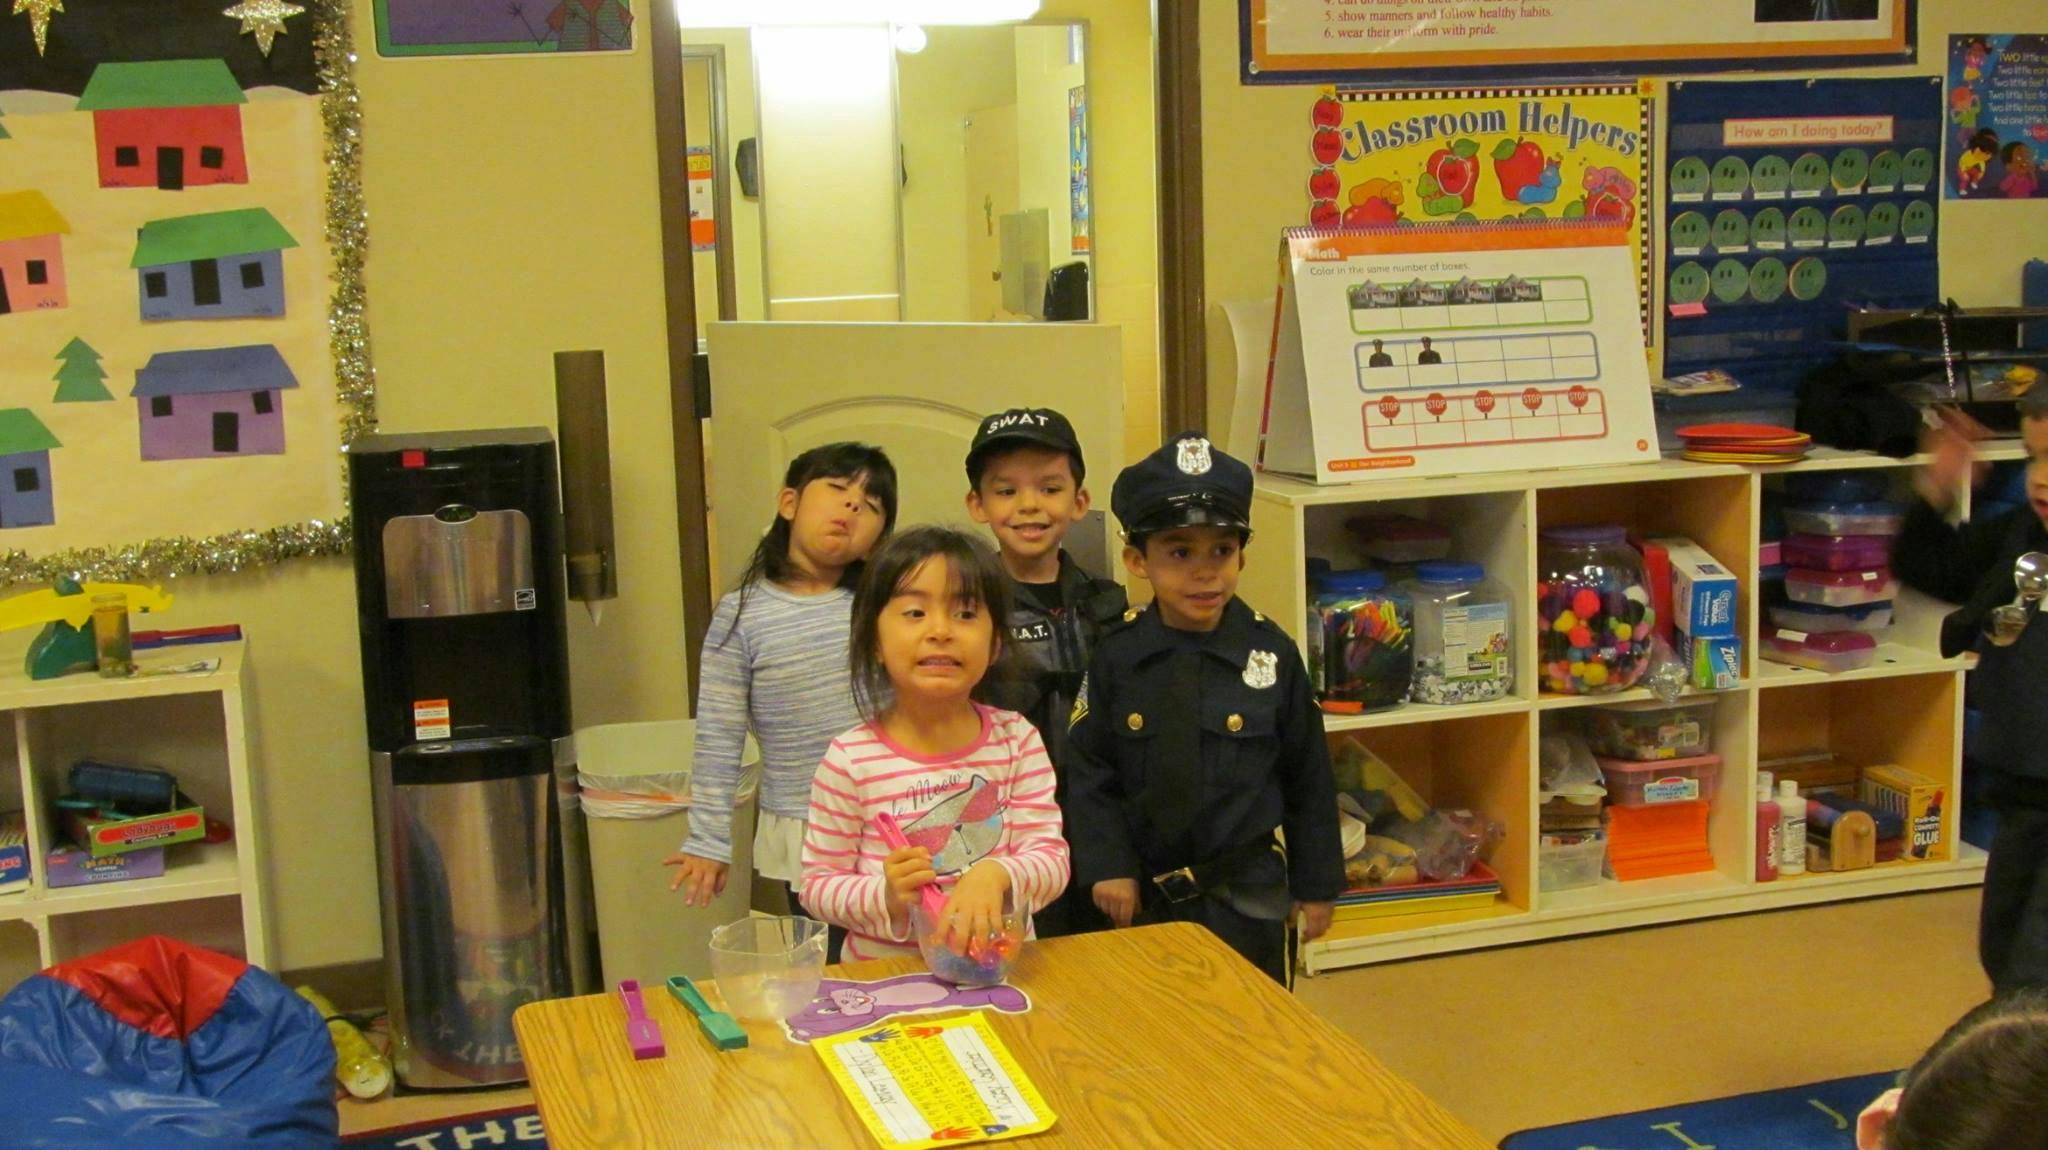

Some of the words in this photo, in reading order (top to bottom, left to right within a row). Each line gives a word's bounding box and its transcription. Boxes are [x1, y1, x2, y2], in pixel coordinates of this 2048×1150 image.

[1338, 10, 1366, 21] show
[1369, 12, 1414, 21] manners
[1416, 9, 1437, 19] and
[1440, 7, 1476, 19] follow
[1479, 7, 1516, 20] healthy
[1324, 27, 1335, 38] 6.
[1338, 28, 1364, 38] wear
[1367, 26, 1391, 37] their
[1441, 24, 1466, 35] with
[1341, 106, 1507, 163] Classroom
[1519, 101, 1638, 156] Helpers
[1734, 125, 1764, 138] How
[1768, 127, 1788, 138] am
[1801, 123, 1837, 139] doing
[1841, 121, 1883, 138] today?
[1308, 248, 1341, 260] Math
[1310, 266, 1334, 276] Color
[1337, 266, 1346, 275] in
[1349, 265, 1364, 275] the
[1367, 266, 1390, 274] same
[1392, 263, 1427, 273] number
[1430, 262, 1440, 271] of
[1442, 261, 1471, 271] boxes.
[1474, 397, 1495, 407] STOP
[1522, 394, 1542, 404] STOP
[1569, 391, 1589, 402] STOP
[1380, 402, 1400, 413] STOP
[1426, 400, 1447, 410] STOP
[987, 413, 1049, 434] SWAT
[906, 773, 961, 811] Meow
[1913, 831, 1940, 846] GLUE
